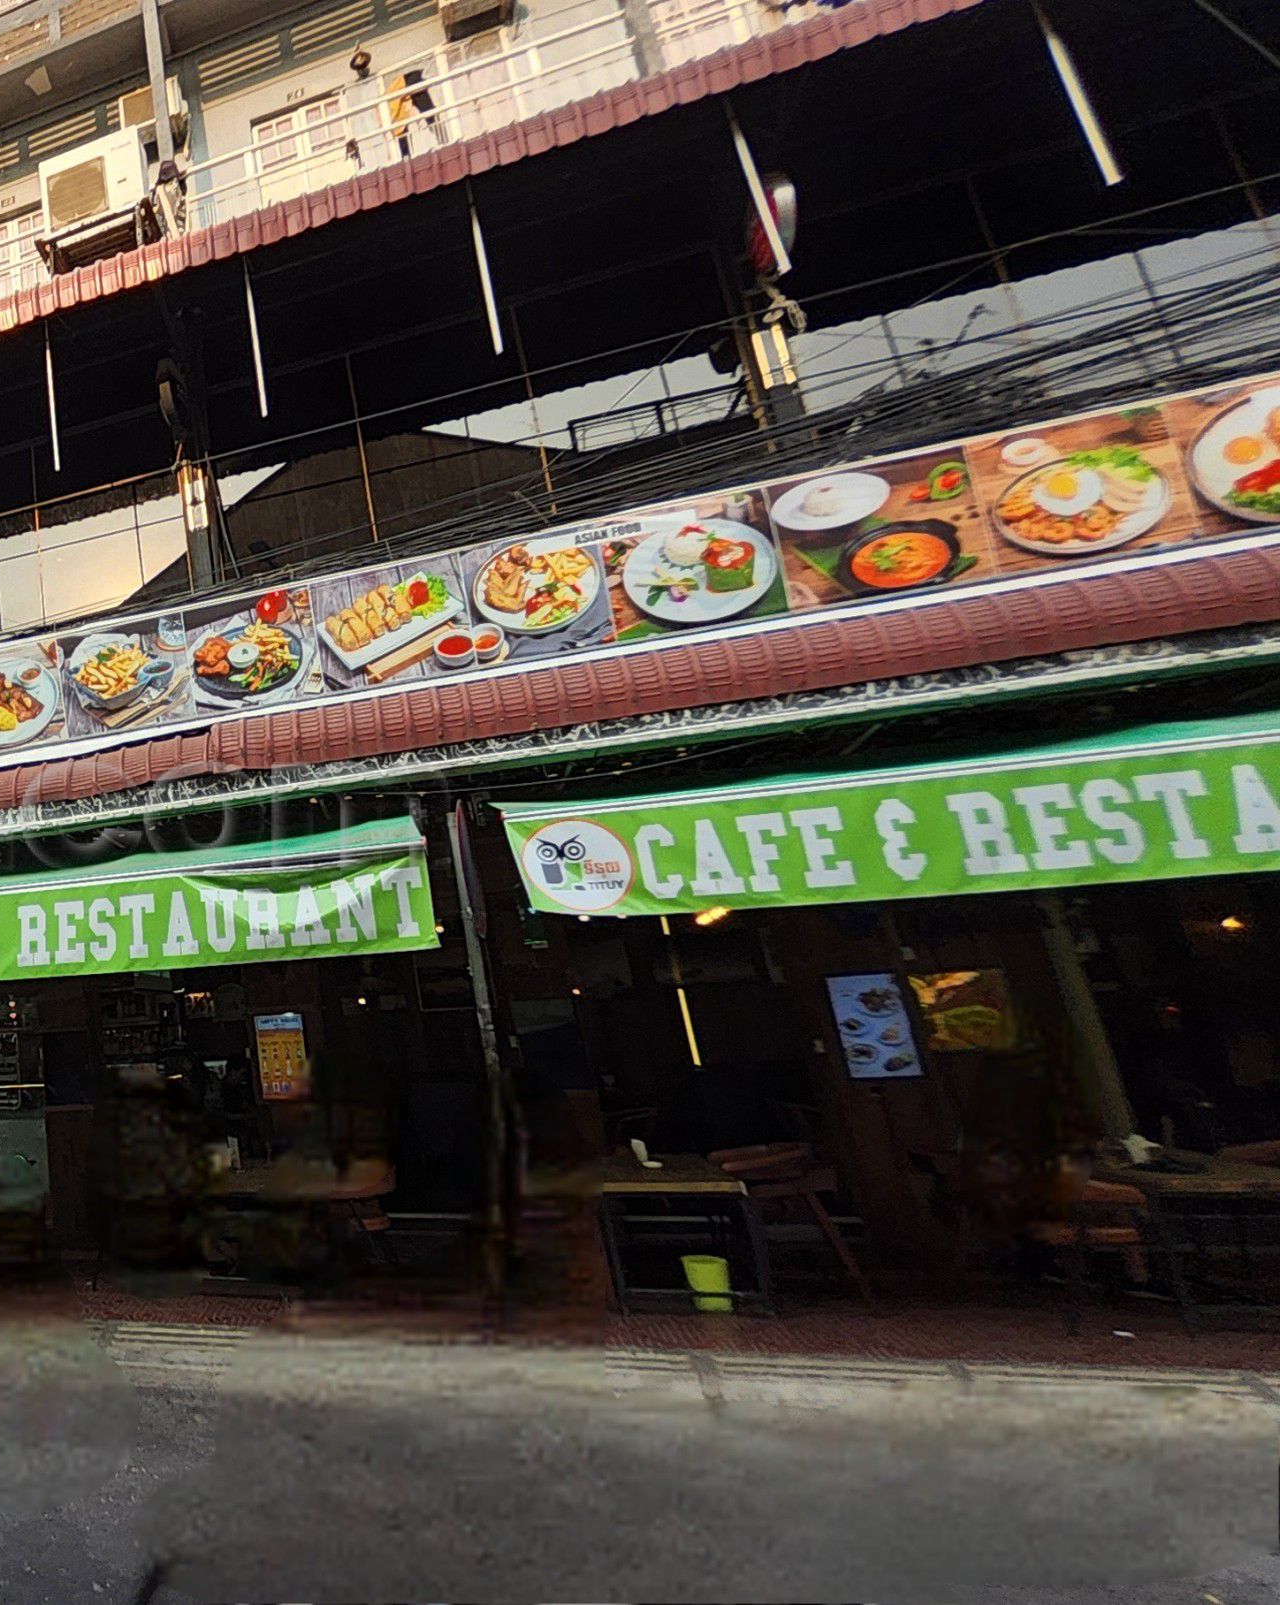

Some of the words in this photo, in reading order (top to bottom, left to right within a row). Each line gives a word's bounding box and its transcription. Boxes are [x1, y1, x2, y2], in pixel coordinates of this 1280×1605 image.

[575, 529, 609, 545] ASIAN
[611, 522, 642, 538] FOOD
[634, 807, 853, 900] CAFE
[874, 798, 926, 882] &
[587, 880, 624, 891] TITUY
[17, 866, 424, 969] RESTAURANT
